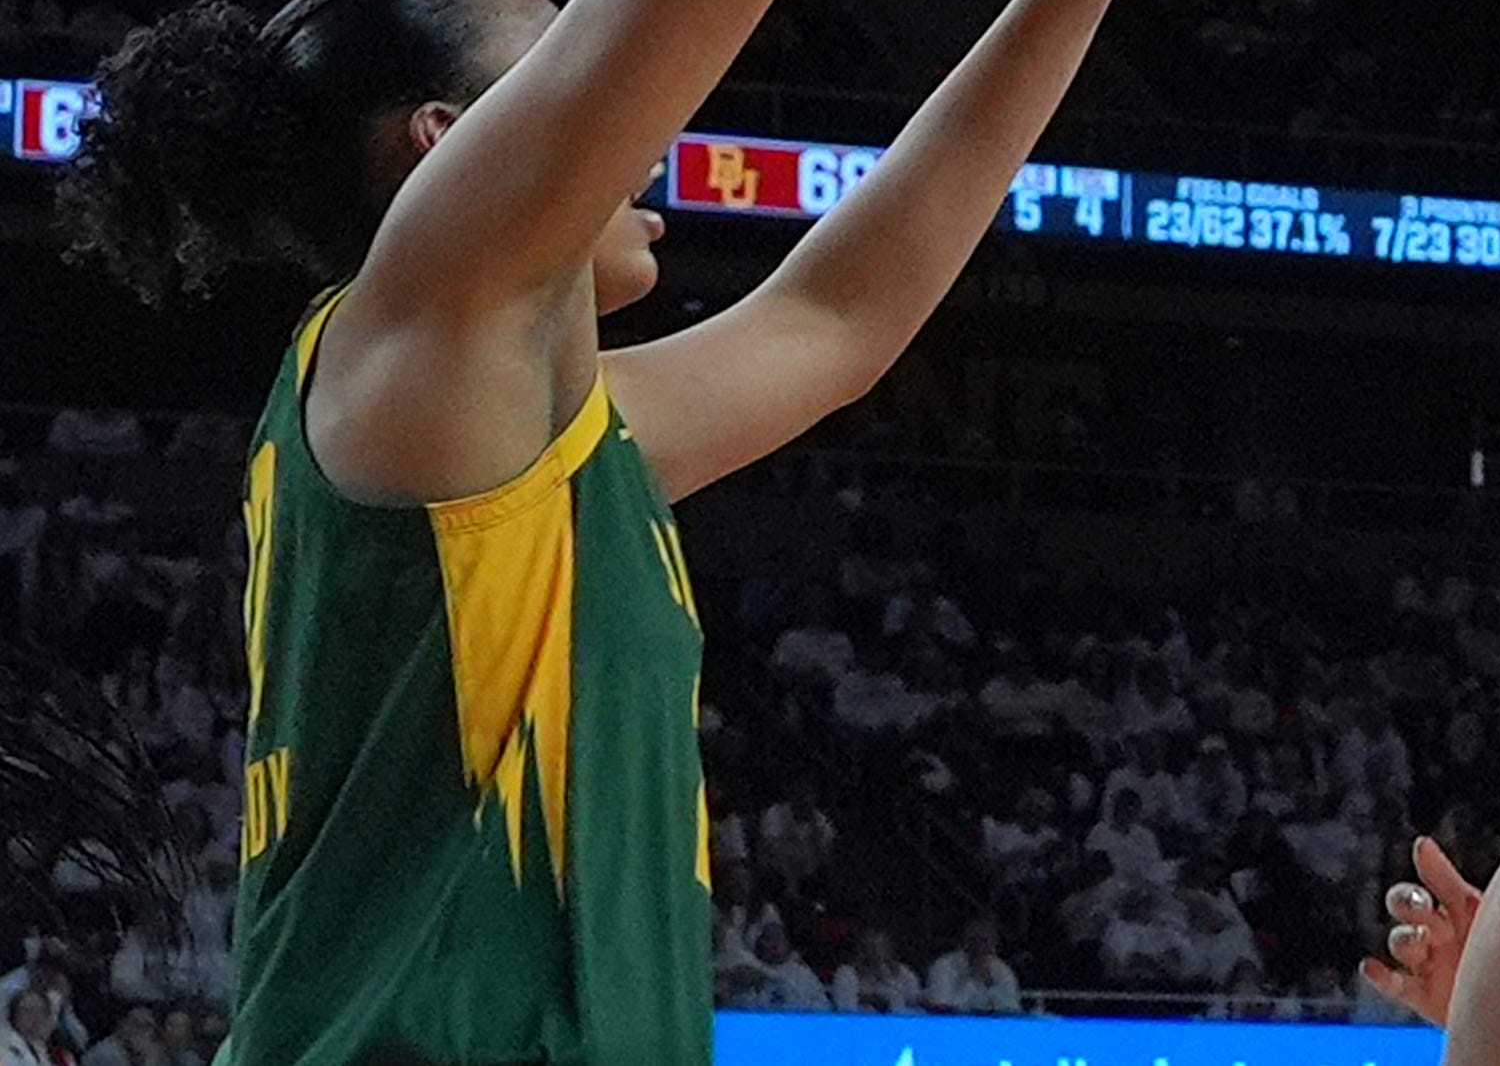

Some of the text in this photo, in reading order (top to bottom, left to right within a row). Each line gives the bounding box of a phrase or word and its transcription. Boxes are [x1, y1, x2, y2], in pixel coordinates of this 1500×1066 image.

[1075, 195, 1104, 236] 4
[1250, 208, 1351, 256] 37.1%
[1371, 216, 1451, 263] 7/23
